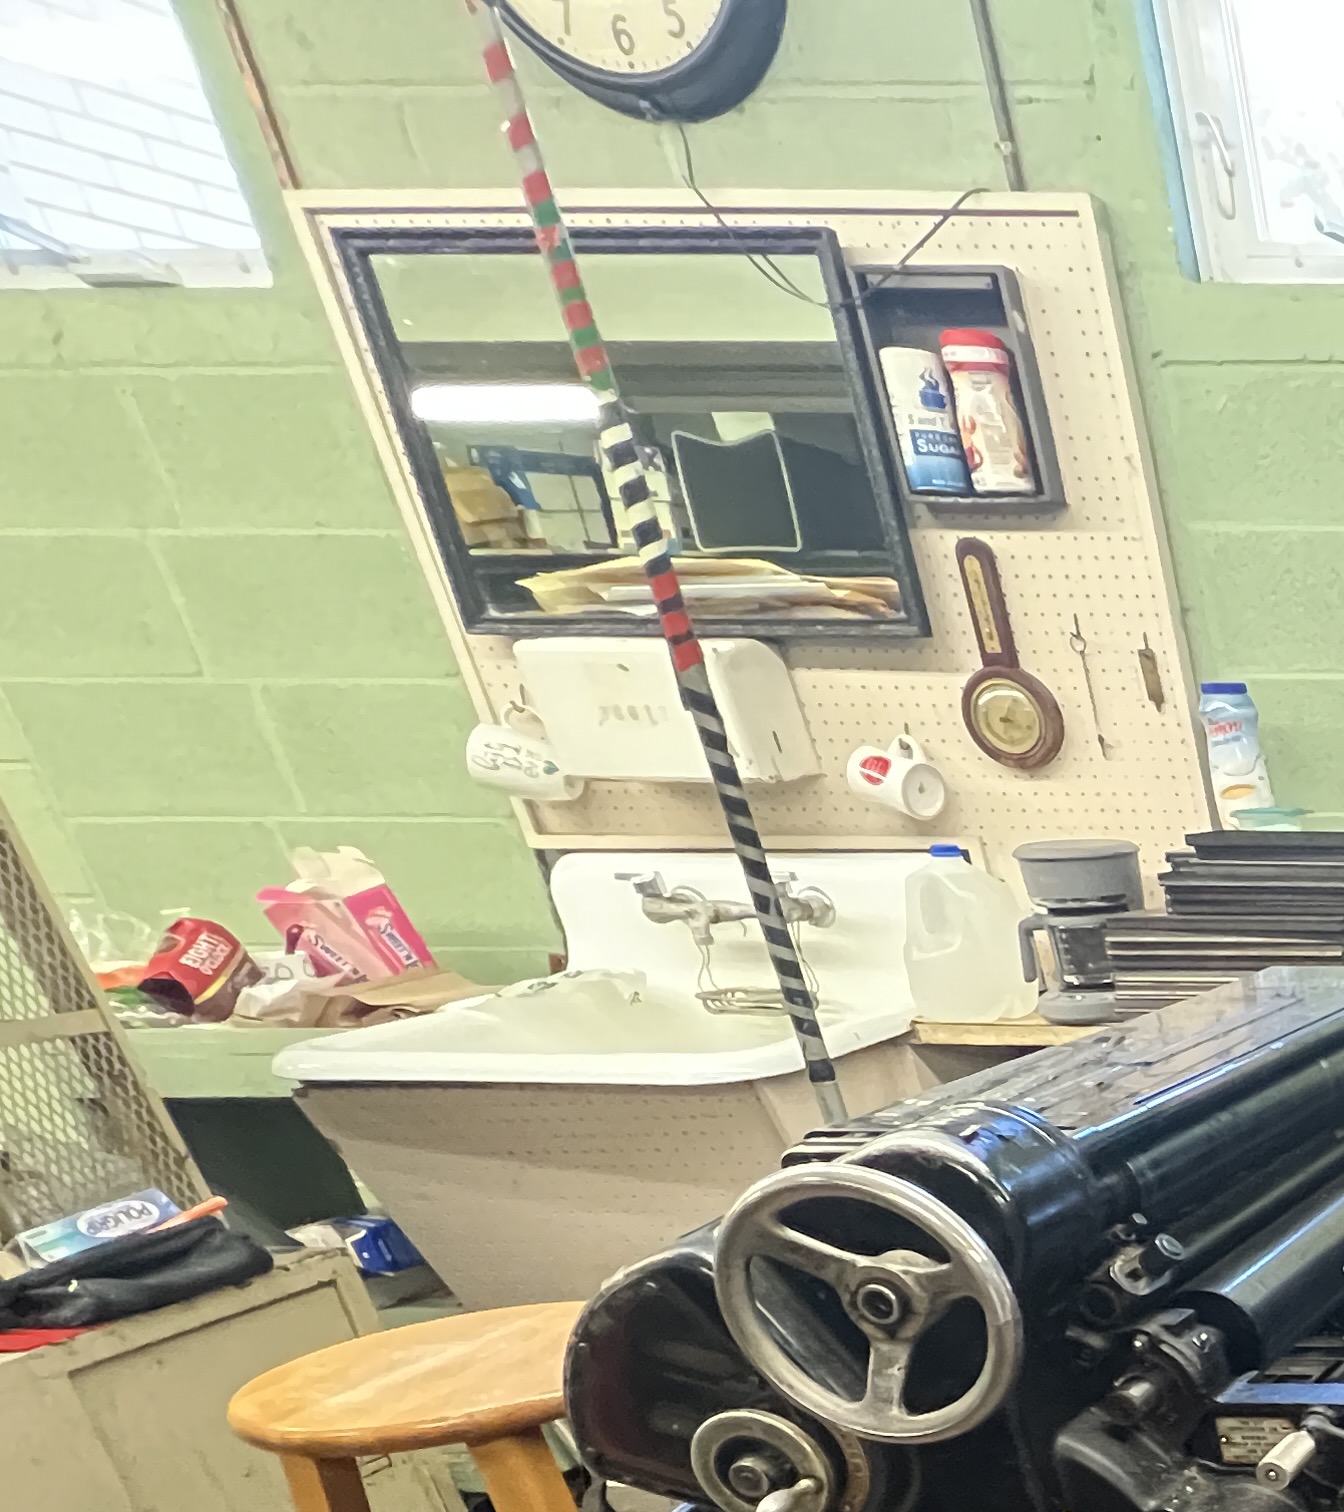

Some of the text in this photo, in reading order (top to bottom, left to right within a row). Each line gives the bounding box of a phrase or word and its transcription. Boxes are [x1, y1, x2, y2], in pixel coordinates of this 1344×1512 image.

[611, 13, 635, 56] 6
[662, 0, 686, 39] 5
[916, 438, 960, 453] SUGA
